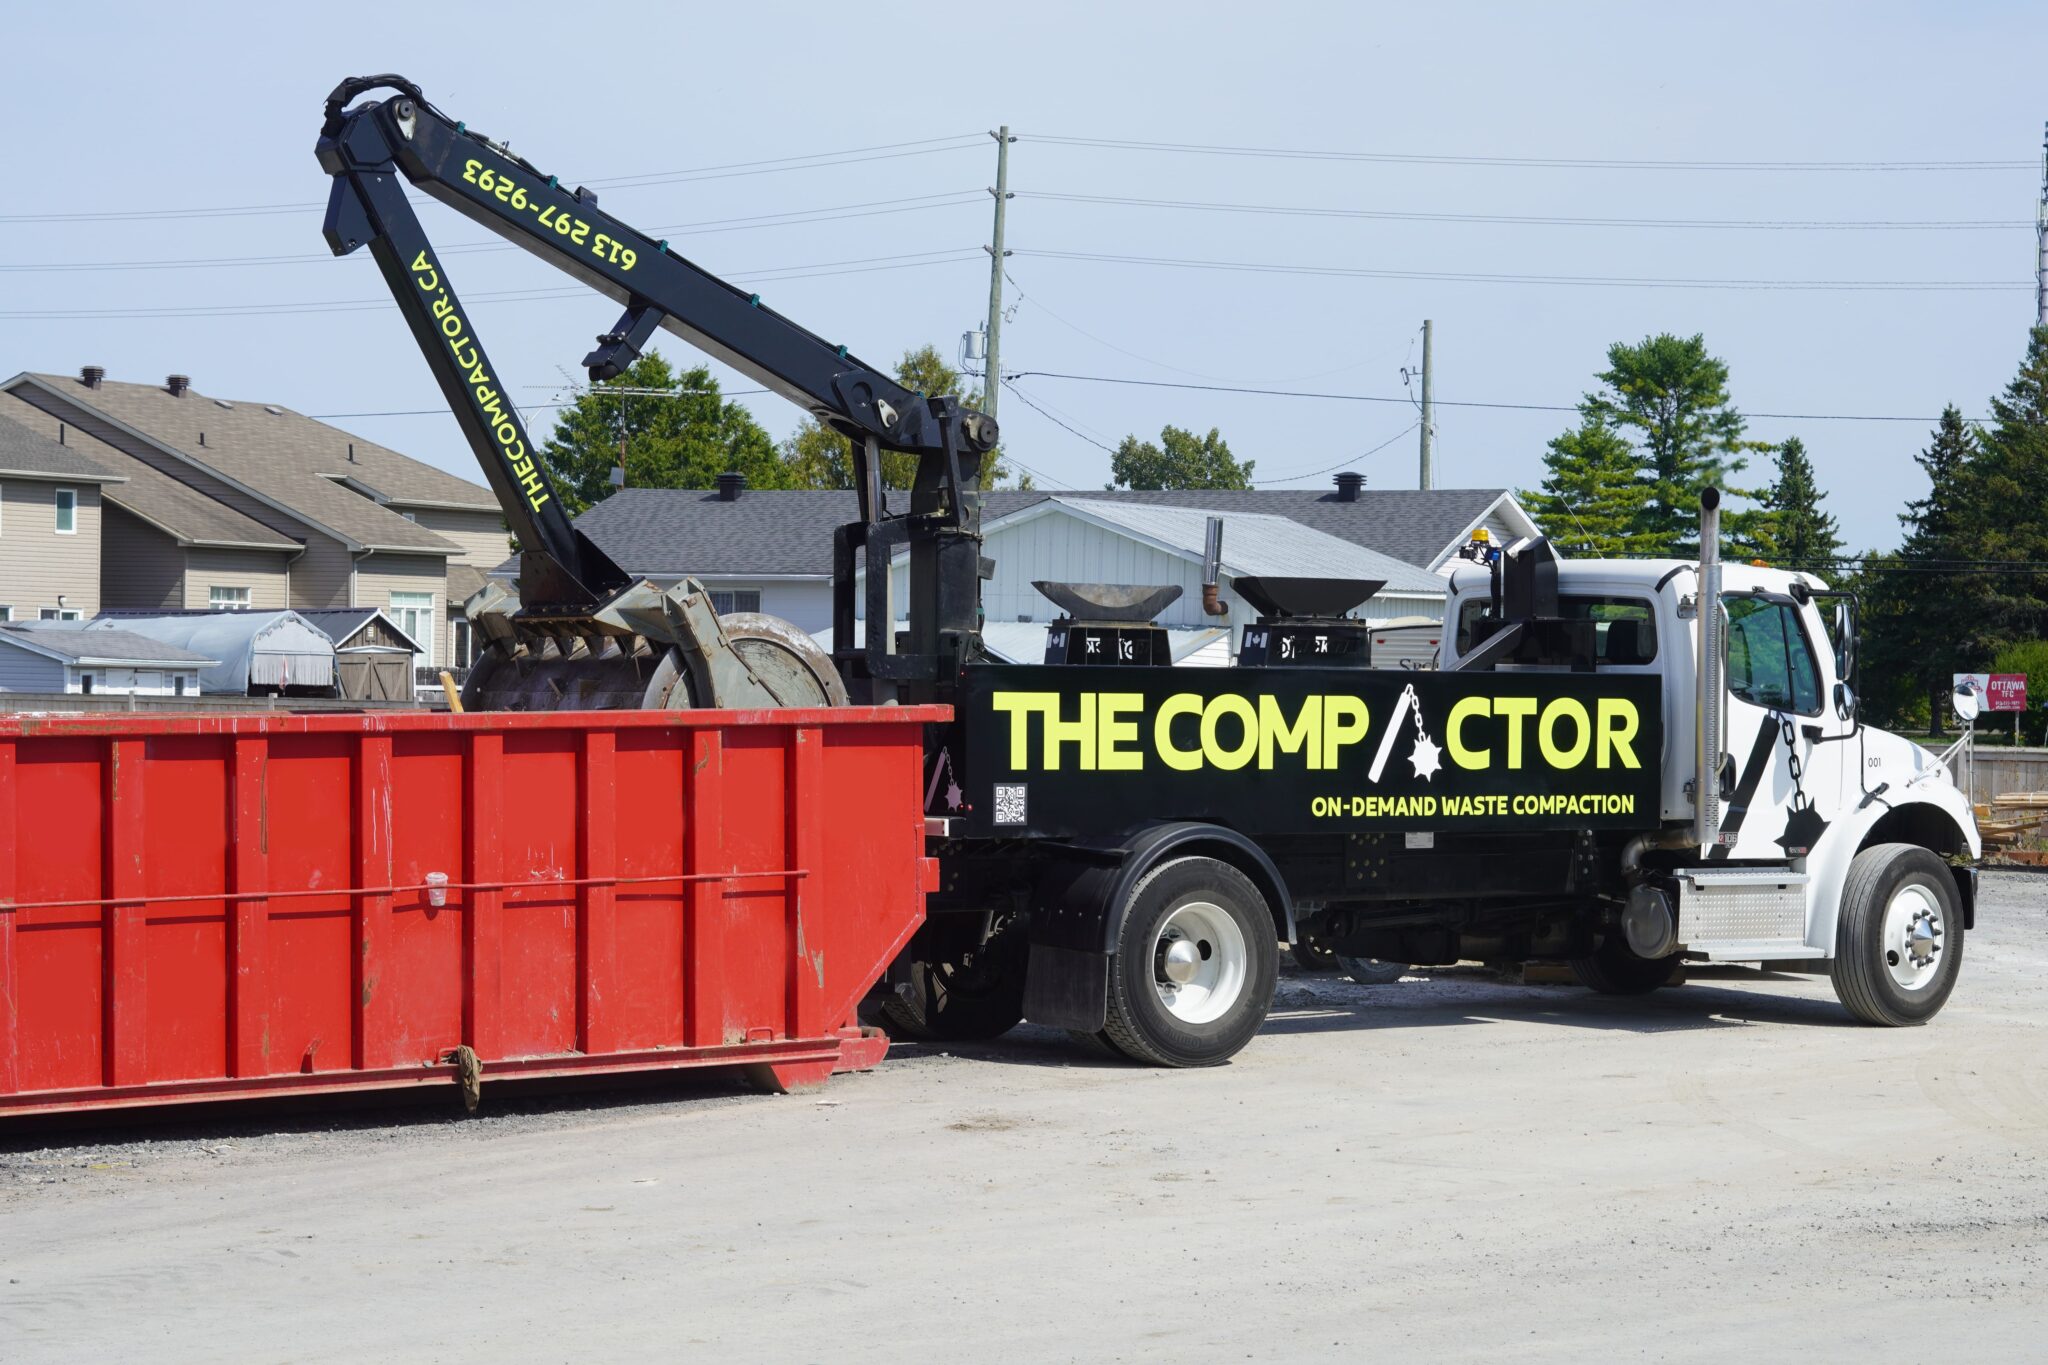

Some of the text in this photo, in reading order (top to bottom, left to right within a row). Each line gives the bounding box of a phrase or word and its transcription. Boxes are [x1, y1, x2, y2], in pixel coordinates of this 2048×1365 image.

[463, 159, 637, 271] 613 297-9293
[411, 251, 550, 513] THECOMPACTOR.CA
[1991, 680, 2025, 690] OTTAWA
[993, 692, 1144, 771] THE
[1867, 757, 1882, 768] 001
[1311, 794, 1635, 817] ON-DEMAND WASTE COMPACTION
